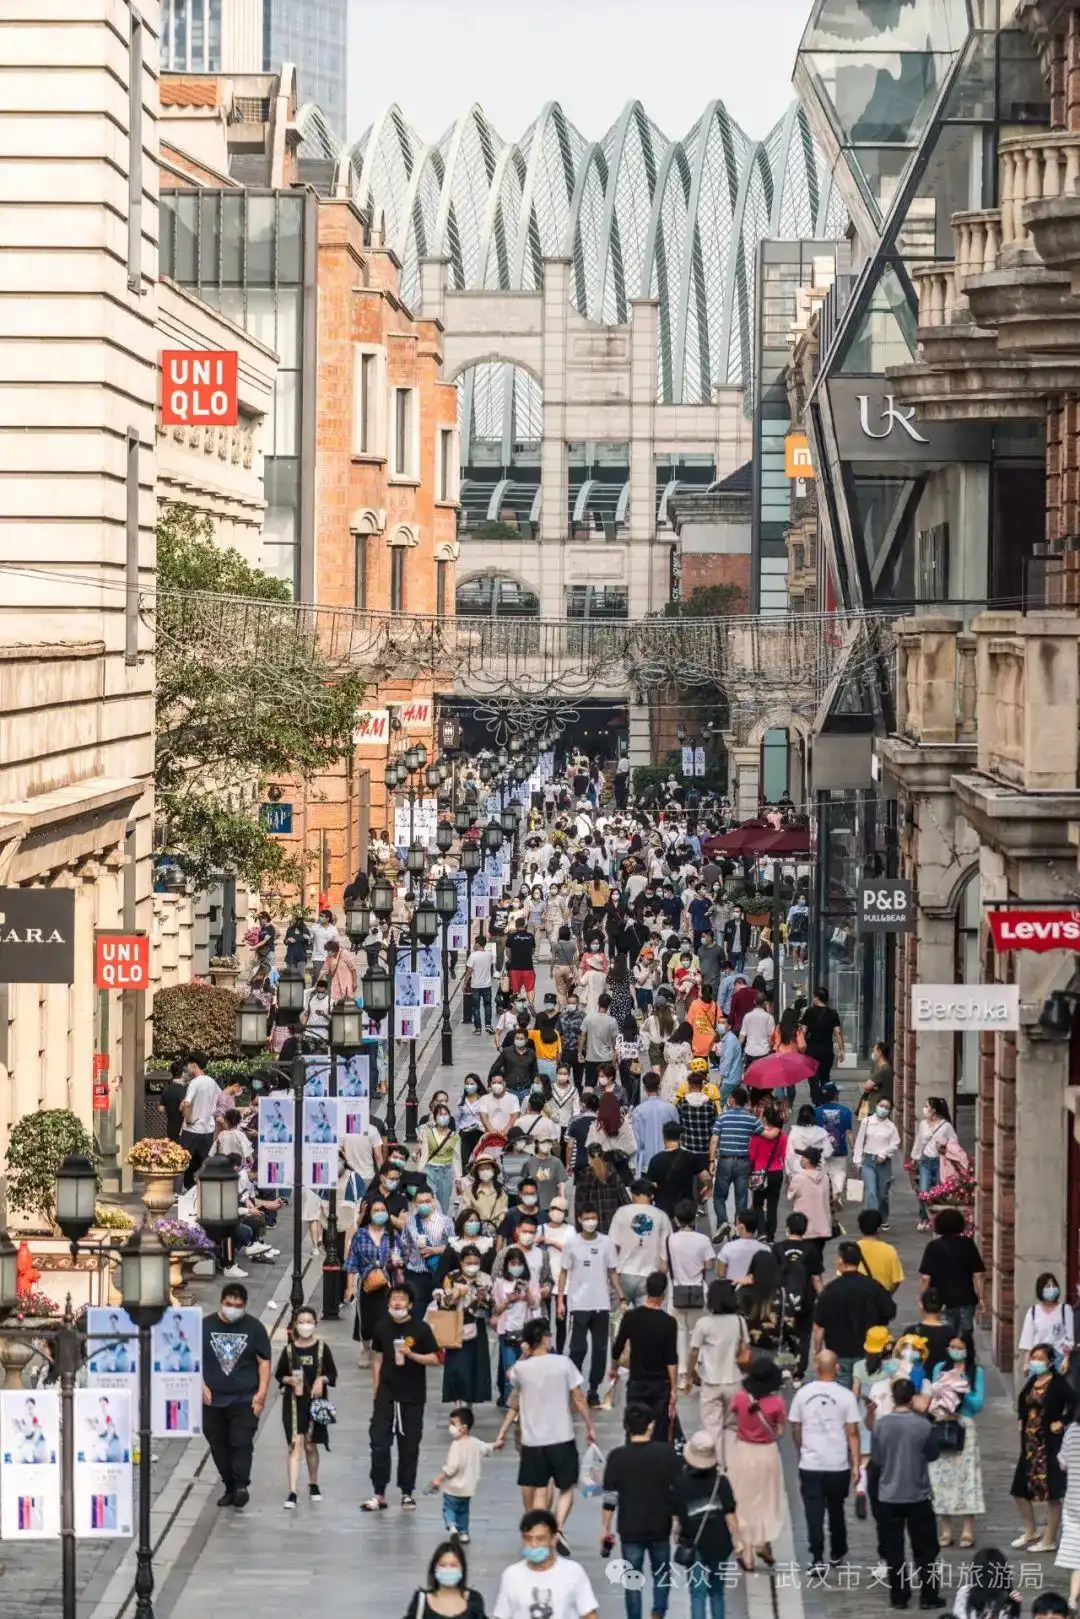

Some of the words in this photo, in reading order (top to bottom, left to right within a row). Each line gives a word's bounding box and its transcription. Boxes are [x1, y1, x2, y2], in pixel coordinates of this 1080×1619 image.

[170, 359, 223, 385] UNI
[170, 390, 229, 421] QLO
[863, 889, 907, 911] P&B
[863, 913, 907, 923] PULL&BEAR
[0, 928, 66, 944] ARA
[102, 943, 139, 961] UNI
[102, 963, 143, 985] QLO
[917, 996, 1008, 1022] Bershka
